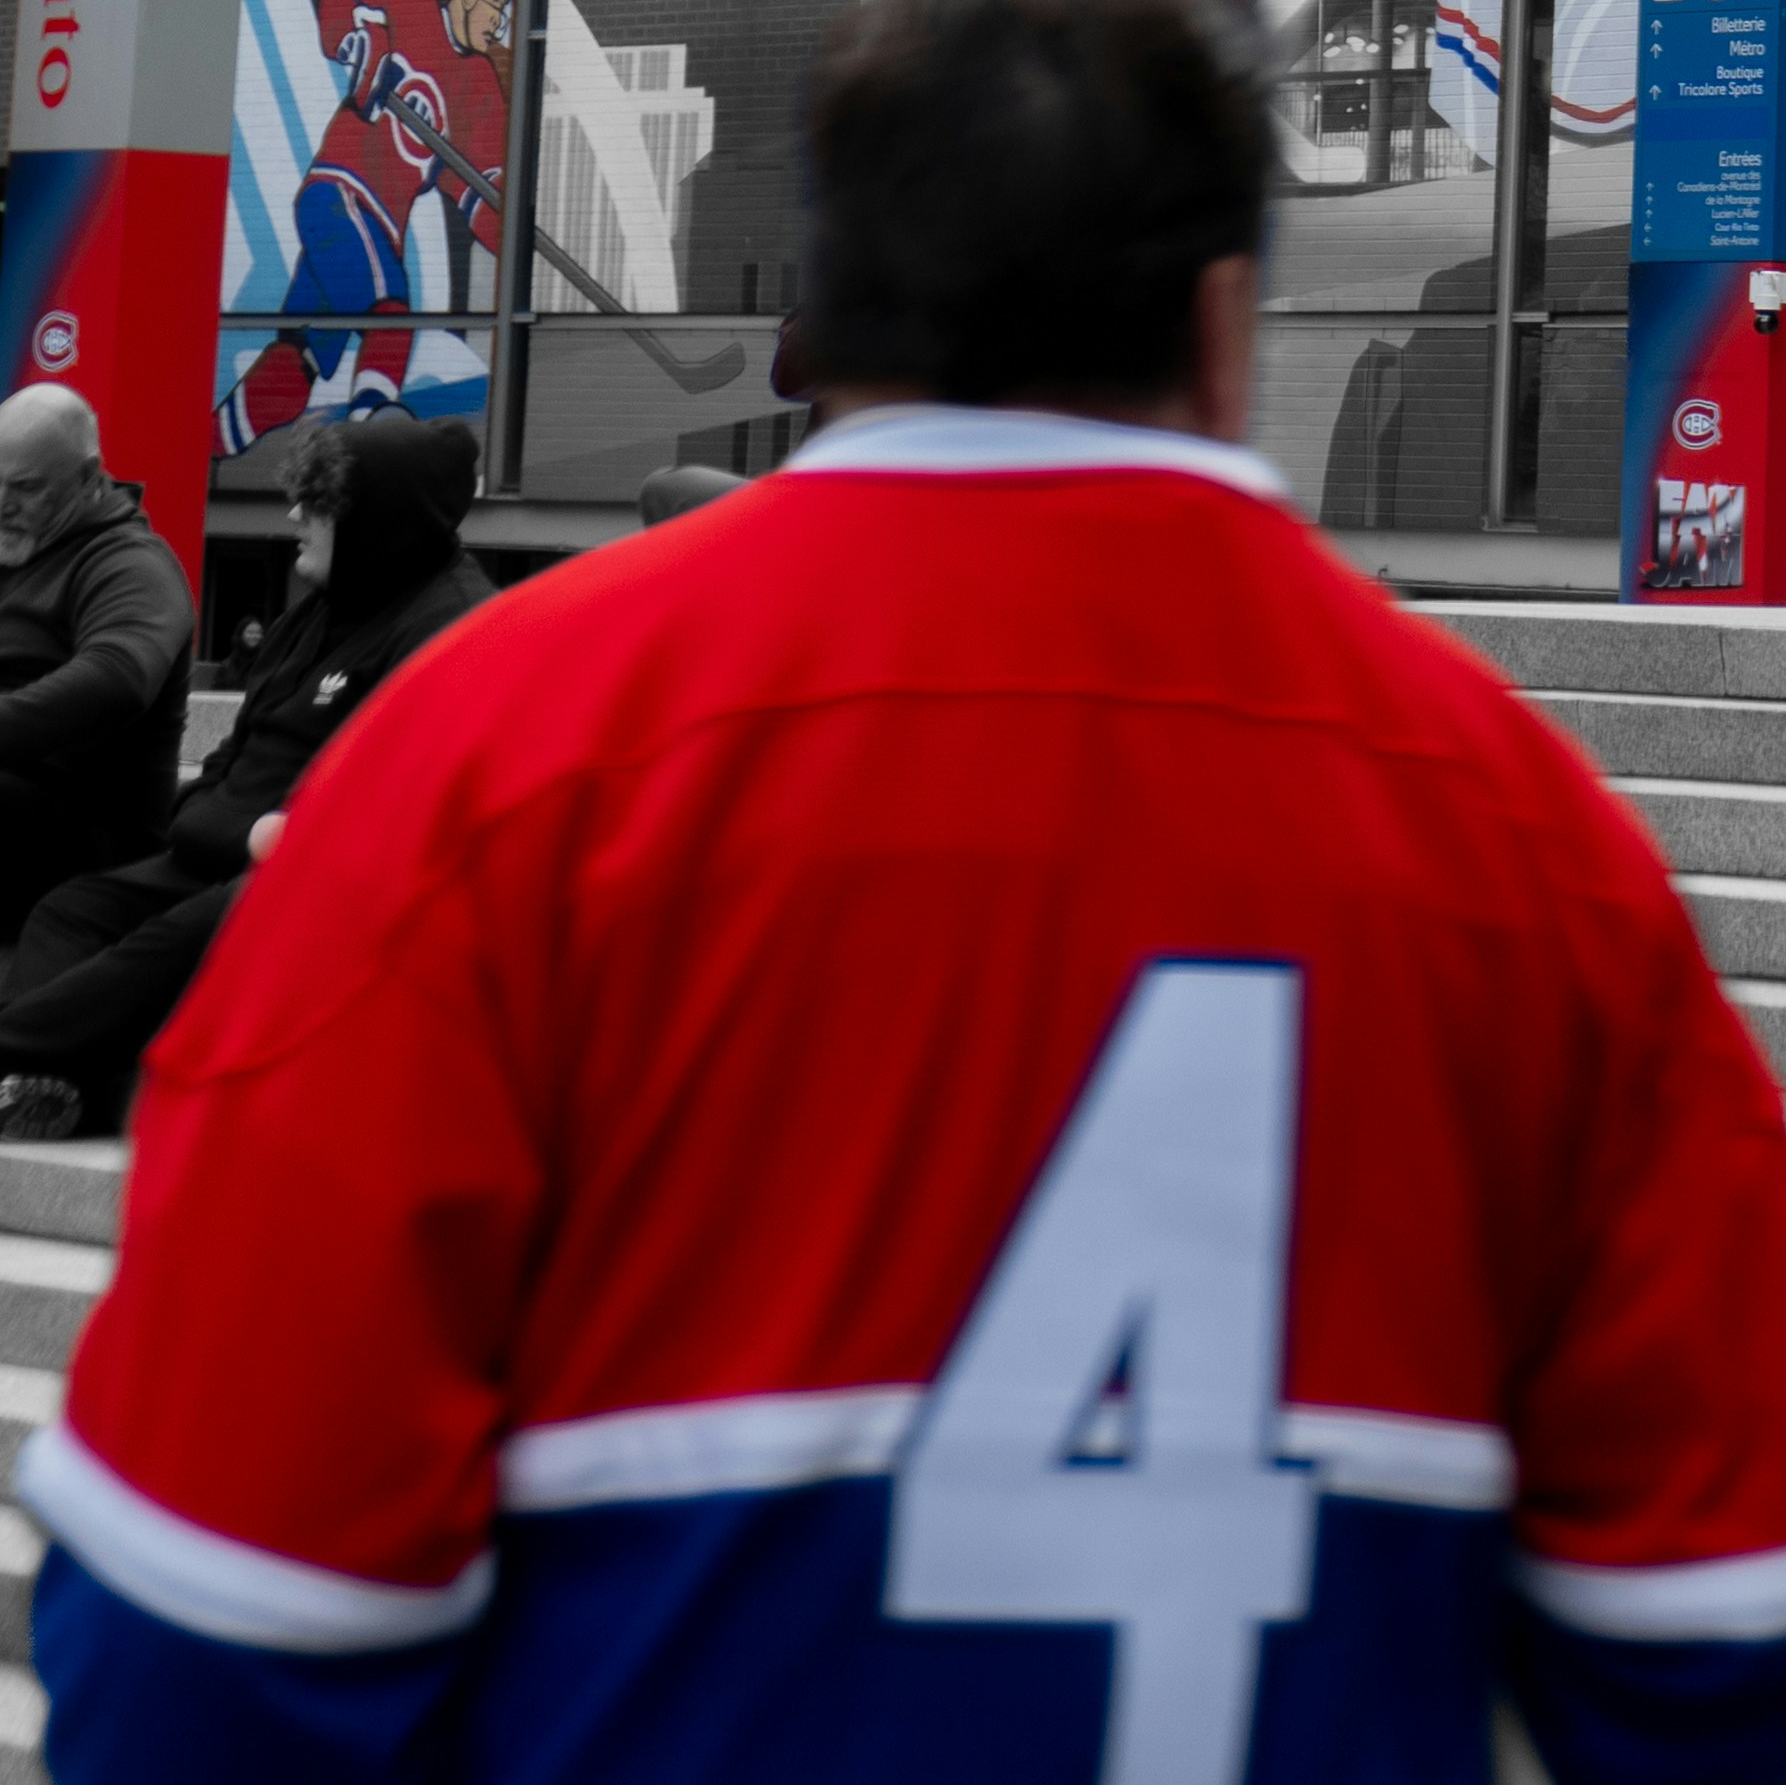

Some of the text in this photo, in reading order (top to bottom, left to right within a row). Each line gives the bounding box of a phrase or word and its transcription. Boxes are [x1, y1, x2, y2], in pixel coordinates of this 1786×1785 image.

[1711, 16, 1766, 33] Billetterie
[1729, 40, 1766, 56] Métro
[1716, 65, 1764, 81] Boutique
[1678, 81, 1763, 98] Tricolore Sports
[1719, 150, 1763, 167] Entrées
[883, 957, 1323, 1785] 4
